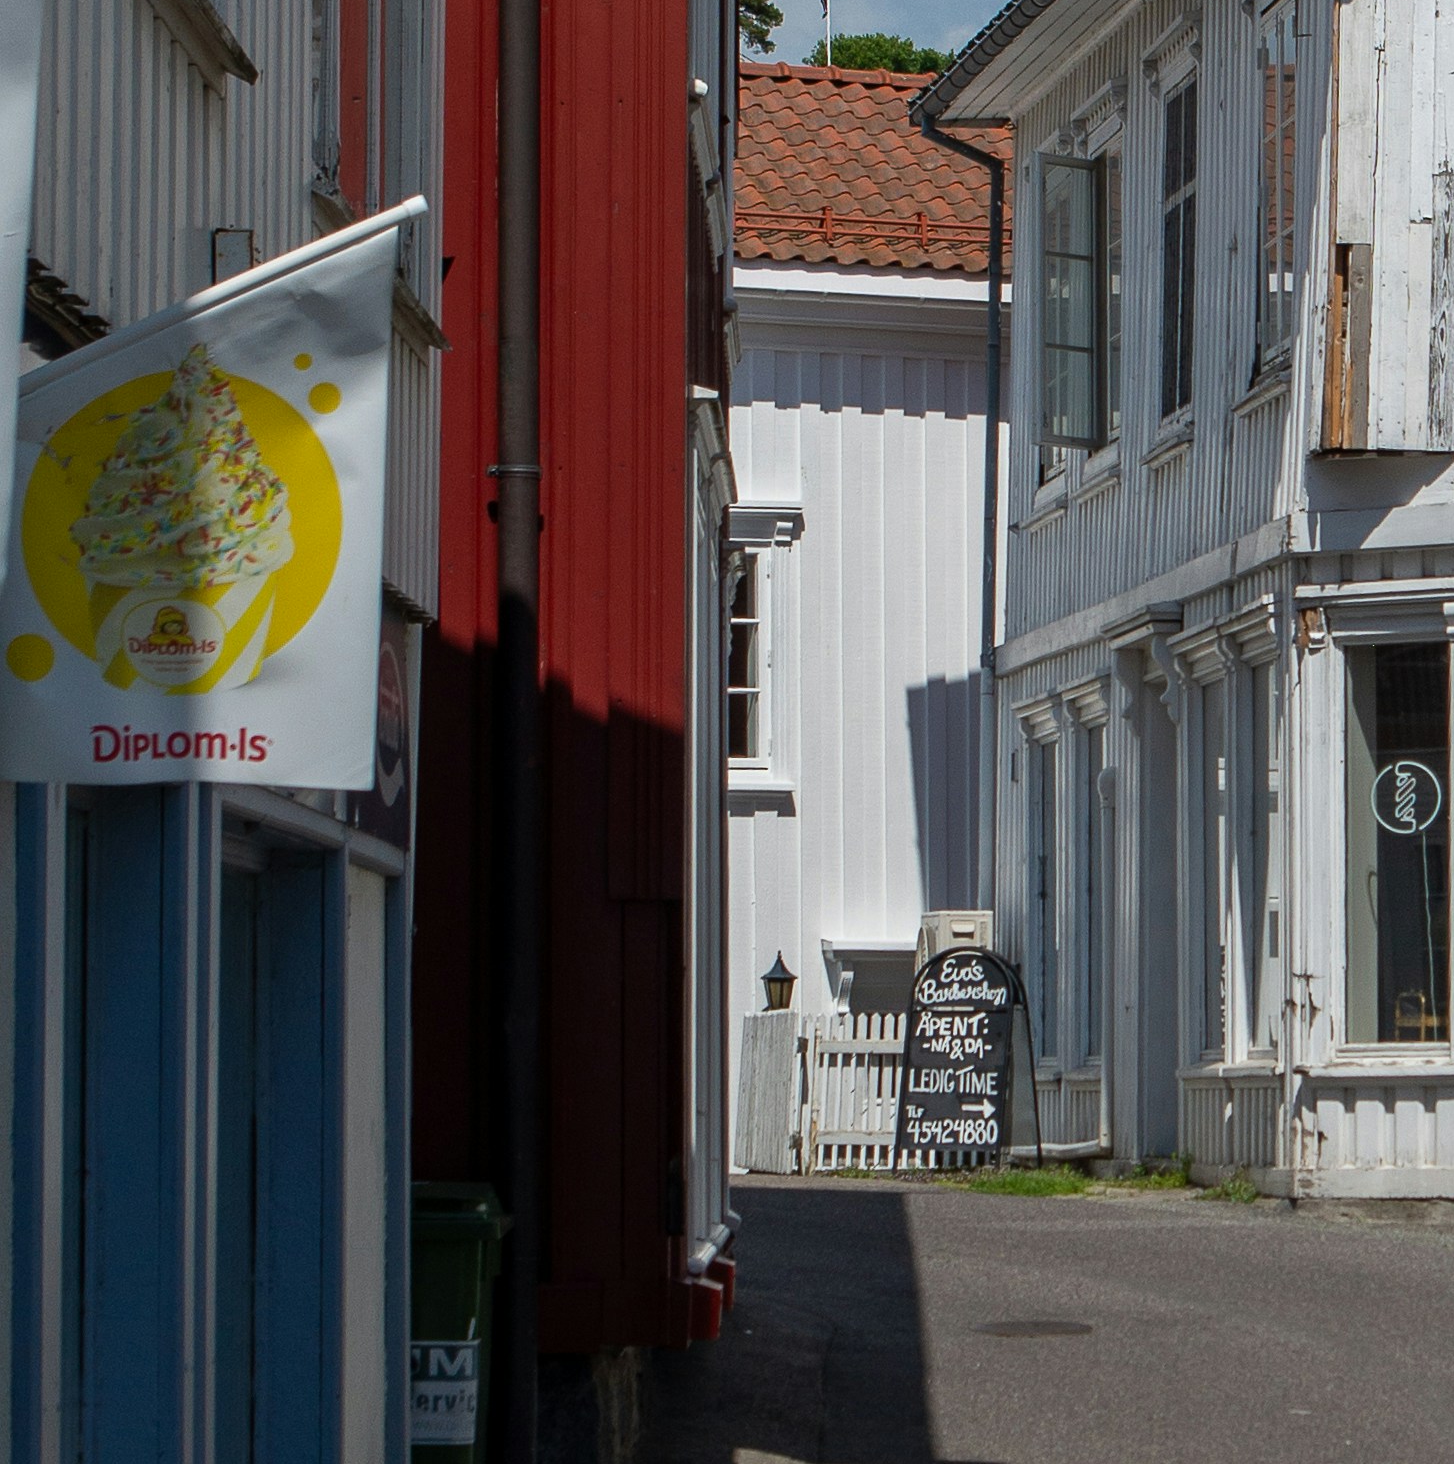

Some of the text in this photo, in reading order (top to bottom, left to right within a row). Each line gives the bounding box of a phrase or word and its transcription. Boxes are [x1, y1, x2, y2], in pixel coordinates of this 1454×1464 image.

[940, 958, 985, 983] Eva's
[918, 979, 1008, 1006] Barbershop
[915, 1011, 989, 1037] ÅPENT:
[908, 1064, 999, 1096] LEDIG TIME
[906, 1118, 999, 1145] 45424880
